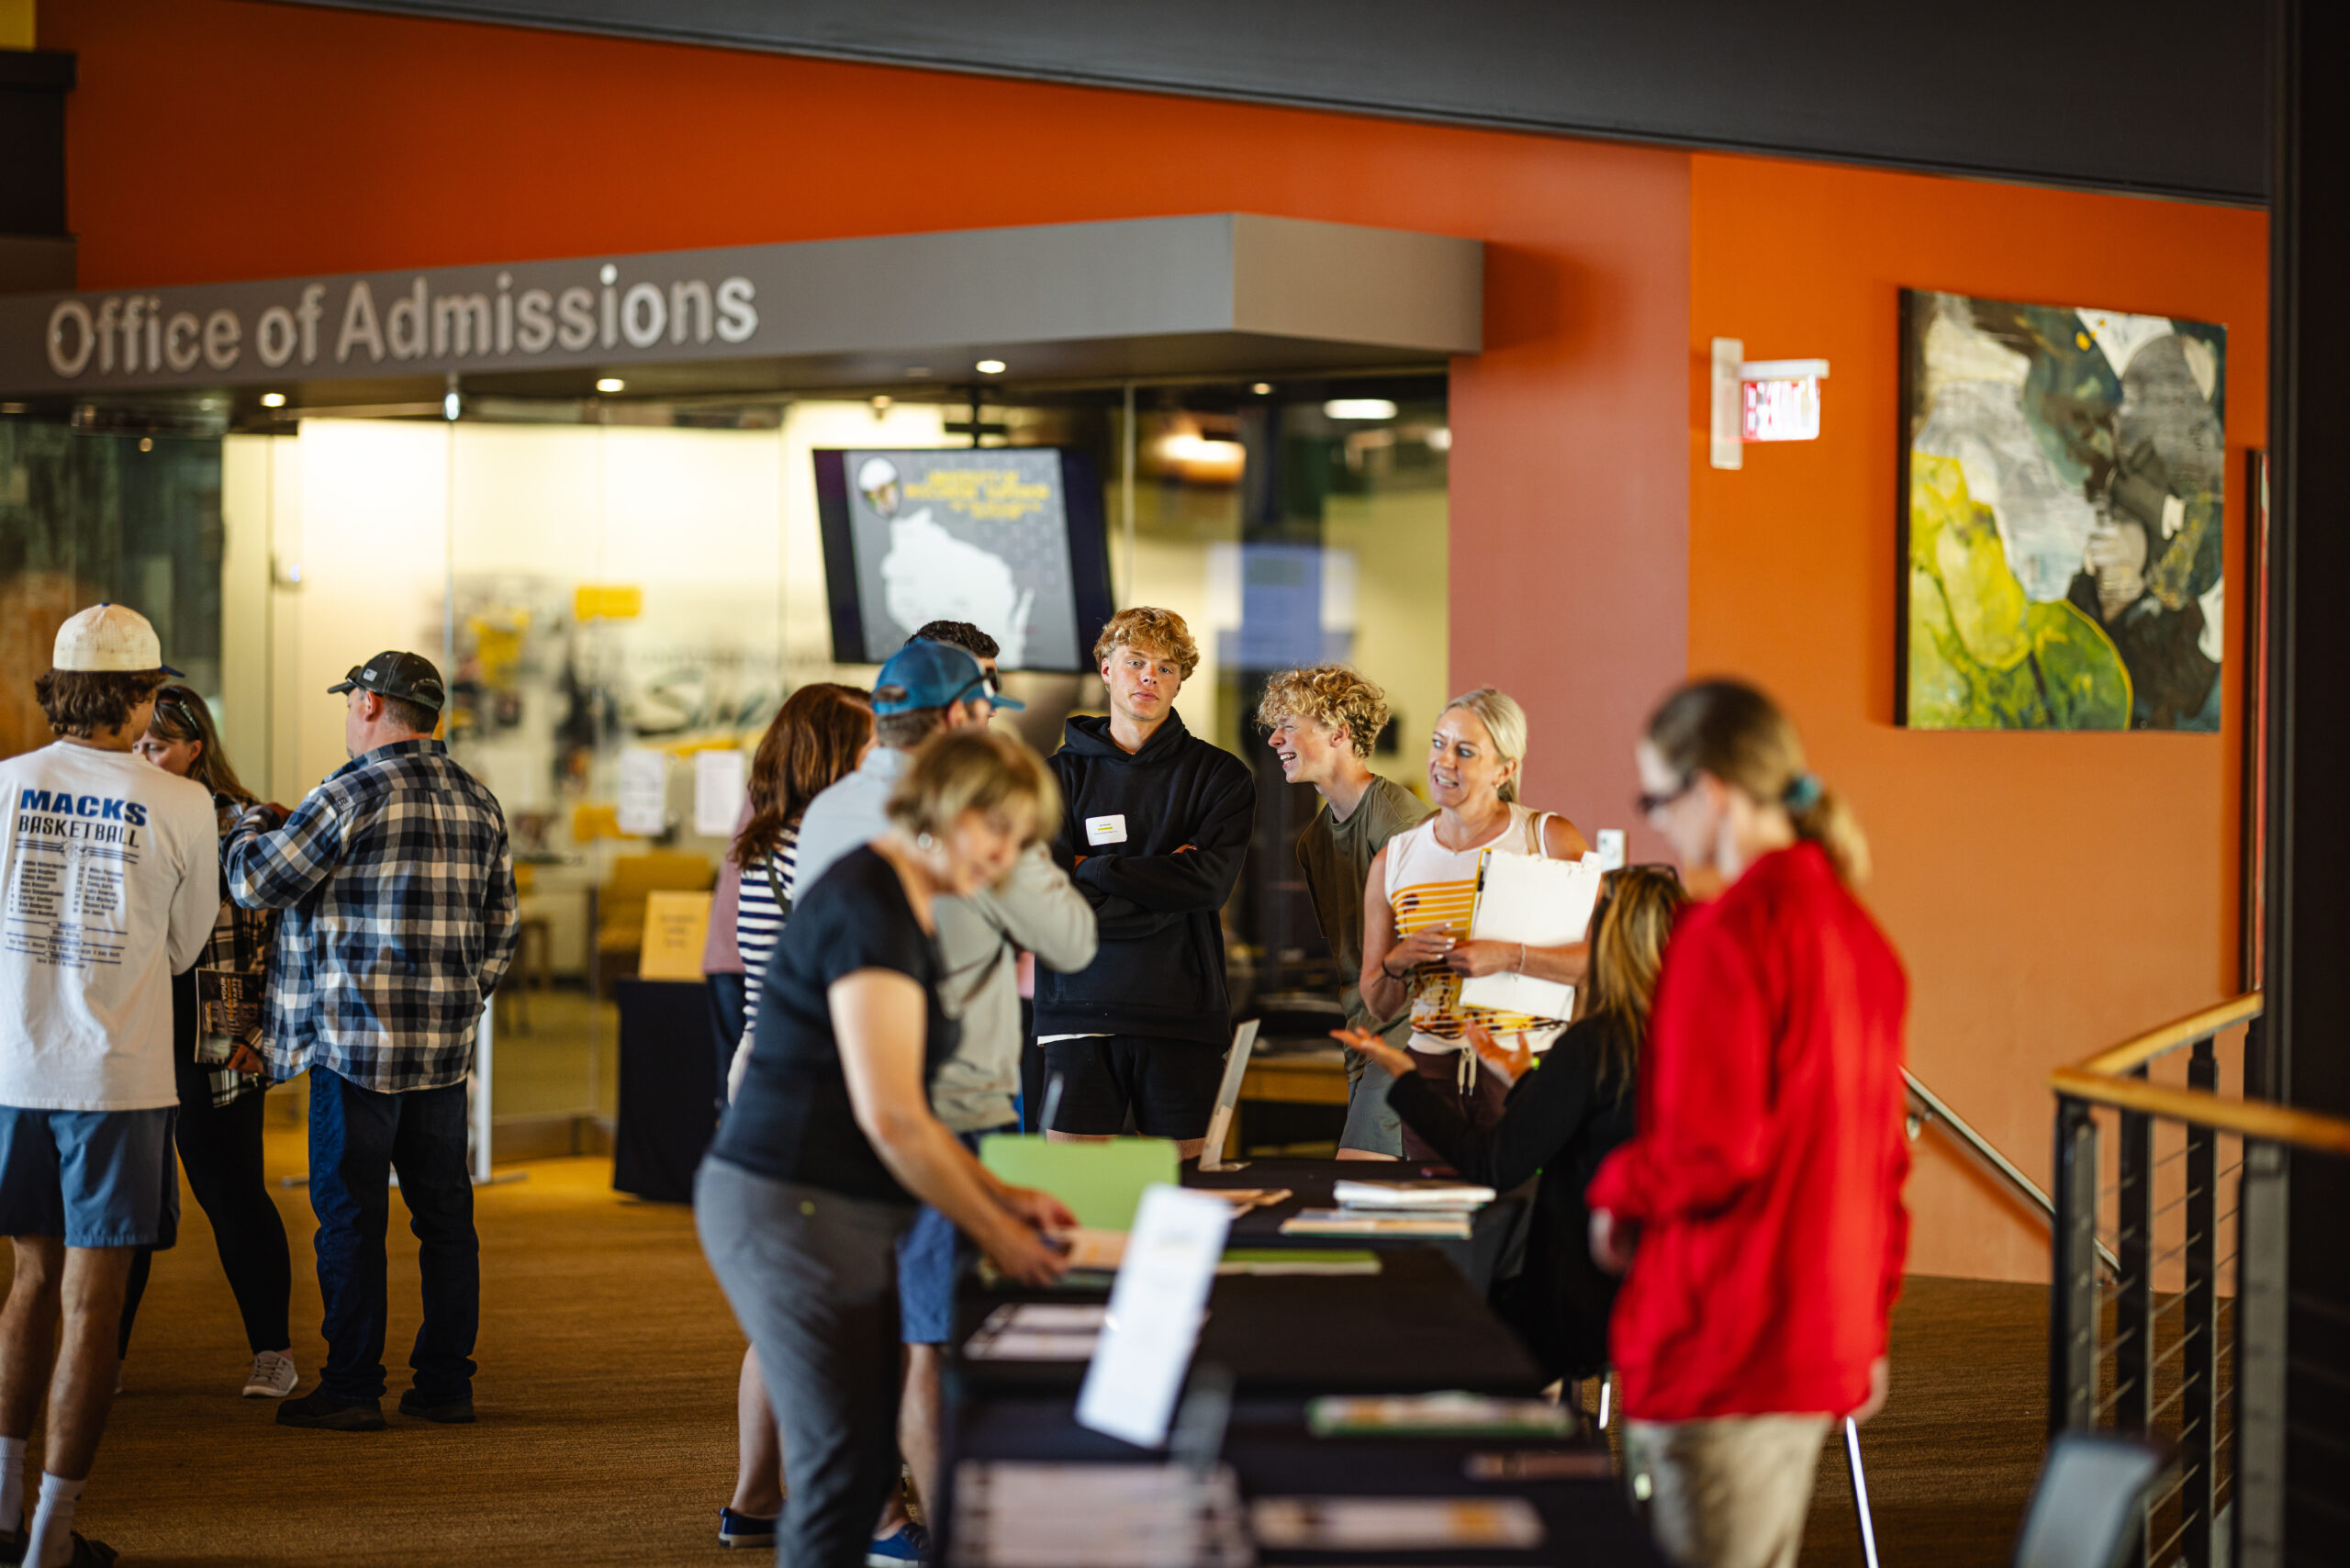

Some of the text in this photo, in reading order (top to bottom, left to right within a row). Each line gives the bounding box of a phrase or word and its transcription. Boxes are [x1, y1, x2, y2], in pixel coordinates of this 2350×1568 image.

[47, 263, 760, 378] Office of Admissions
[19, 789, 148, 827] MACKS
[17, 814, 140, 848] BASKETBALL
